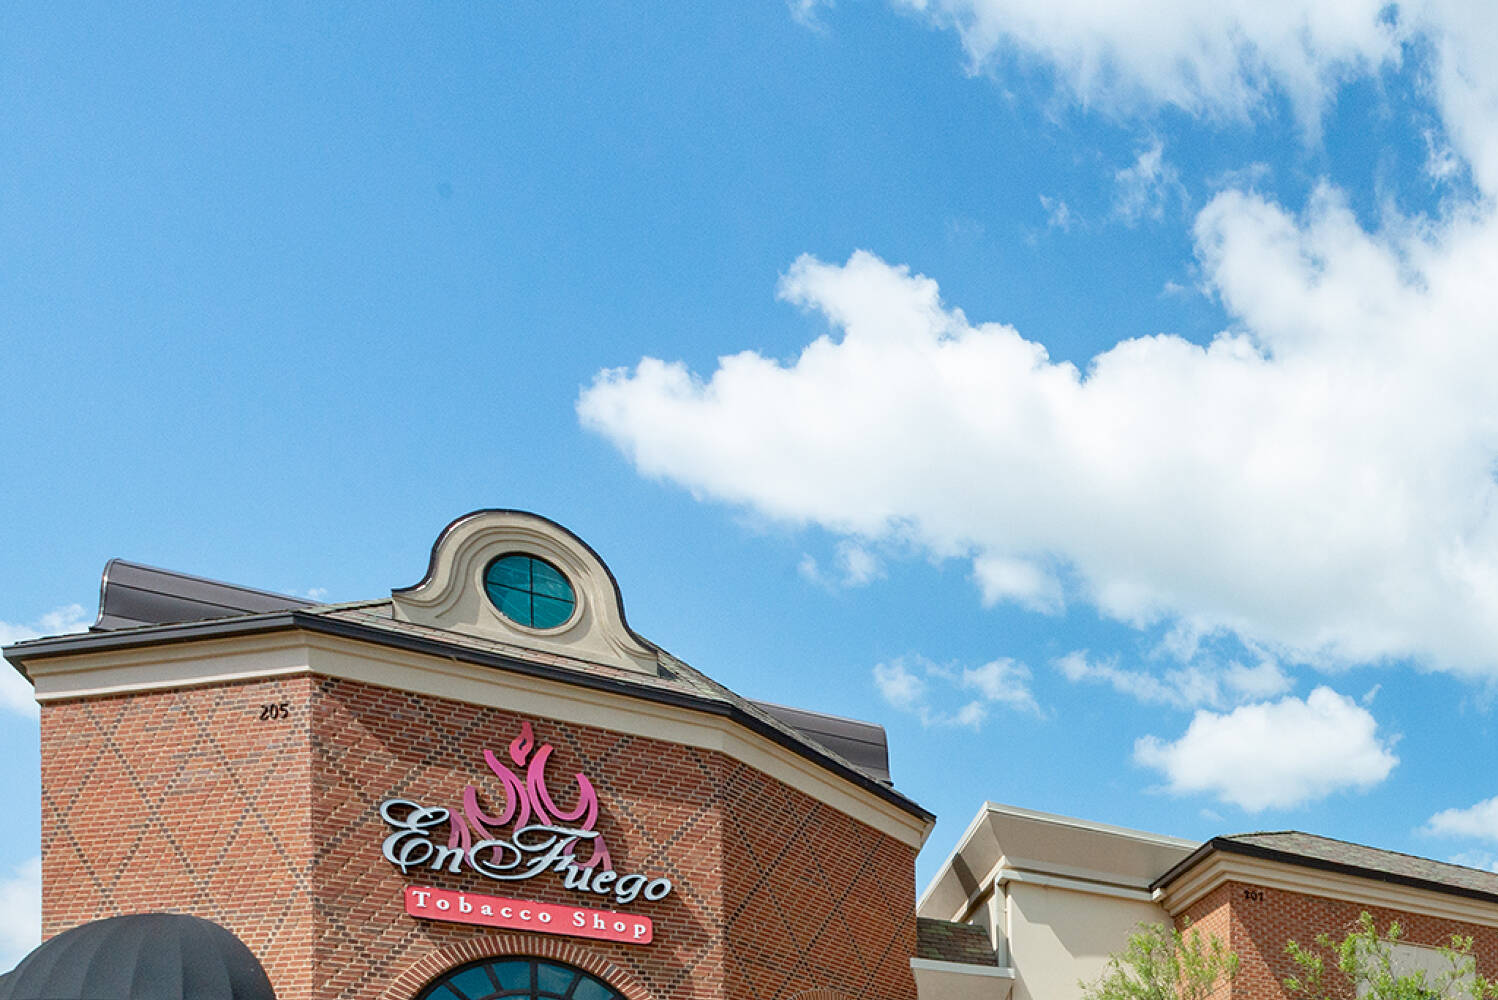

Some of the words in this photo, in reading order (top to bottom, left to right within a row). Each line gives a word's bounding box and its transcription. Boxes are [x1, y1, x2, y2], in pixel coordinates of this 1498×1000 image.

[260, 703, 289, 720] 205
[379, 798, 466, 874] En
[469, 825, 672, 904] Fuego
[412, 890, 551, 923] Tobacco
[572, 910, 647, 939] Shop
